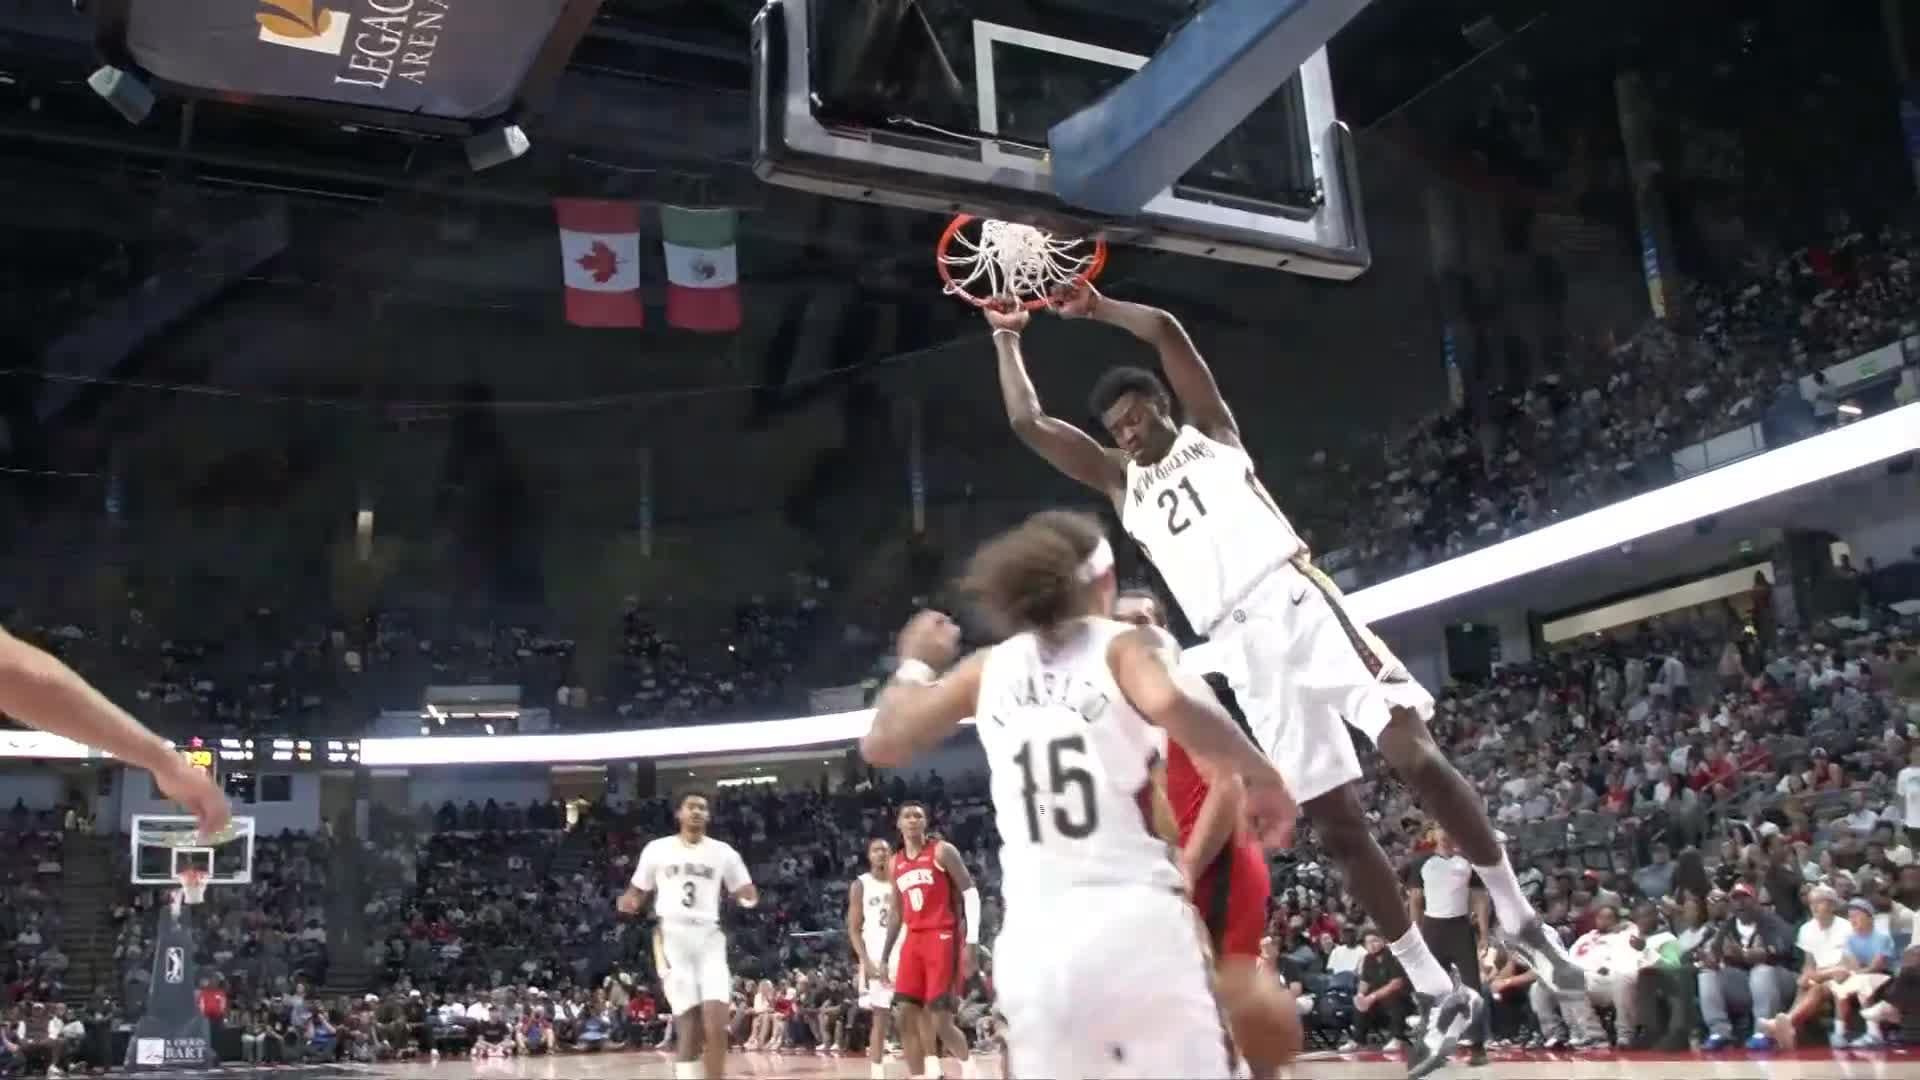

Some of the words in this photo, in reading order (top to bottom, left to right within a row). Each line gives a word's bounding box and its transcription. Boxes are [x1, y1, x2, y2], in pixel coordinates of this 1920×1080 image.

[1157, 476, 1207, 536] 21
[1012, 734, 1099, 845] 15
[681, 881, 697, 908] 3
